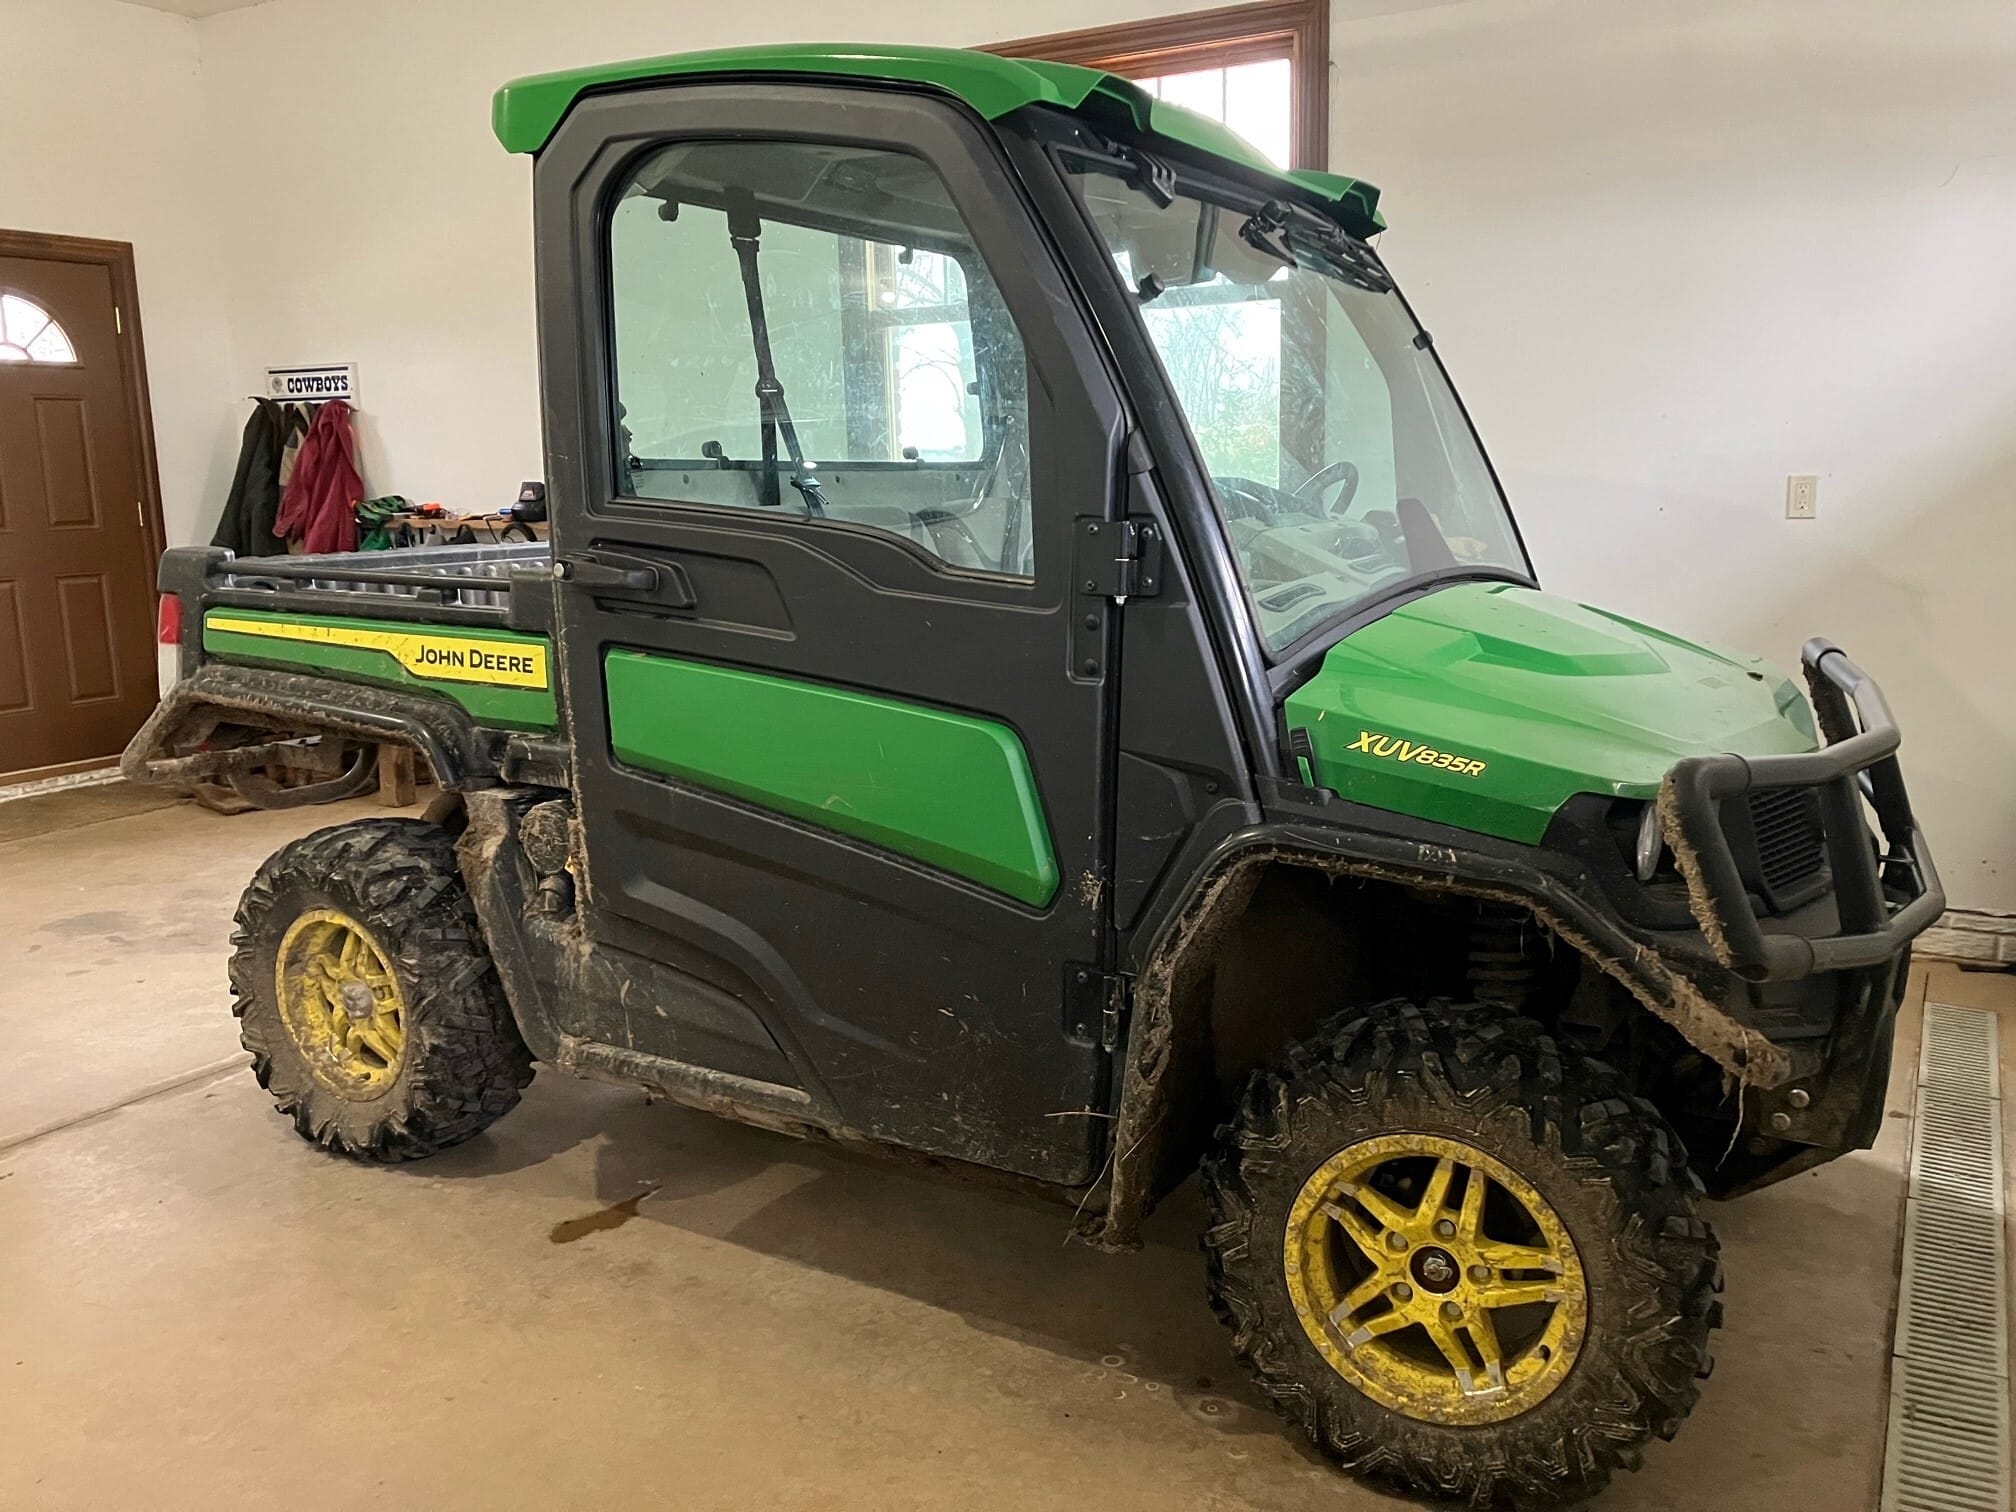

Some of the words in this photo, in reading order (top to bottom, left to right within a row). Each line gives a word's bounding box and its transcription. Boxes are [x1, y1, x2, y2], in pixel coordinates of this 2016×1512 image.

[287, 375, 348, 393] COWBOYS
[415, 645, 464, 667] JOHN
[469, 649, 534, 673] DEERE
[1345, 730, 1487, 777] XUV835R
